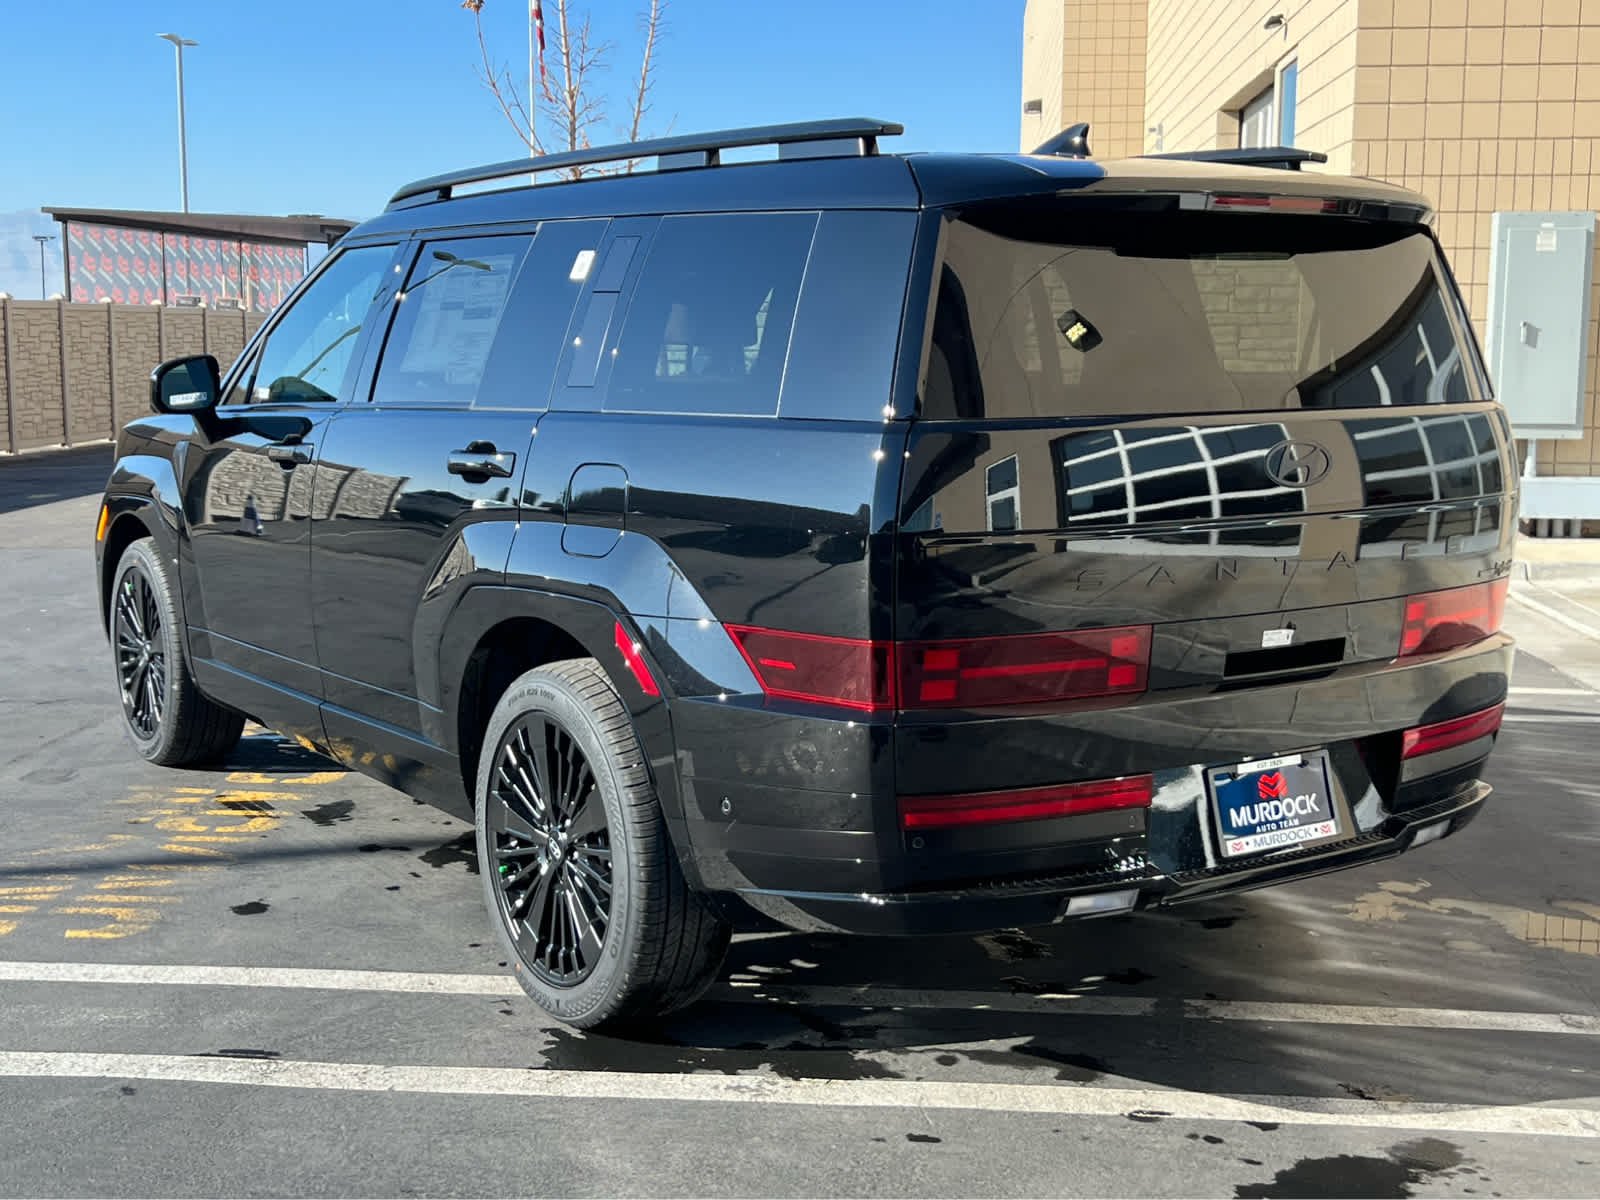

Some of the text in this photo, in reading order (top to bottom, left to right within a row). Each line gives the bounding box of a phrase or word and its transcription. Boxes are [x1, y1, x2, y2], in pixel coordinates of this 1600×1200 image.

[1229, 793, 1320, 828] MURDOCK
[1256, 818, 1300, 833] AUTO TEAM
[1253, 828, 1313, 848] MURDOCK
